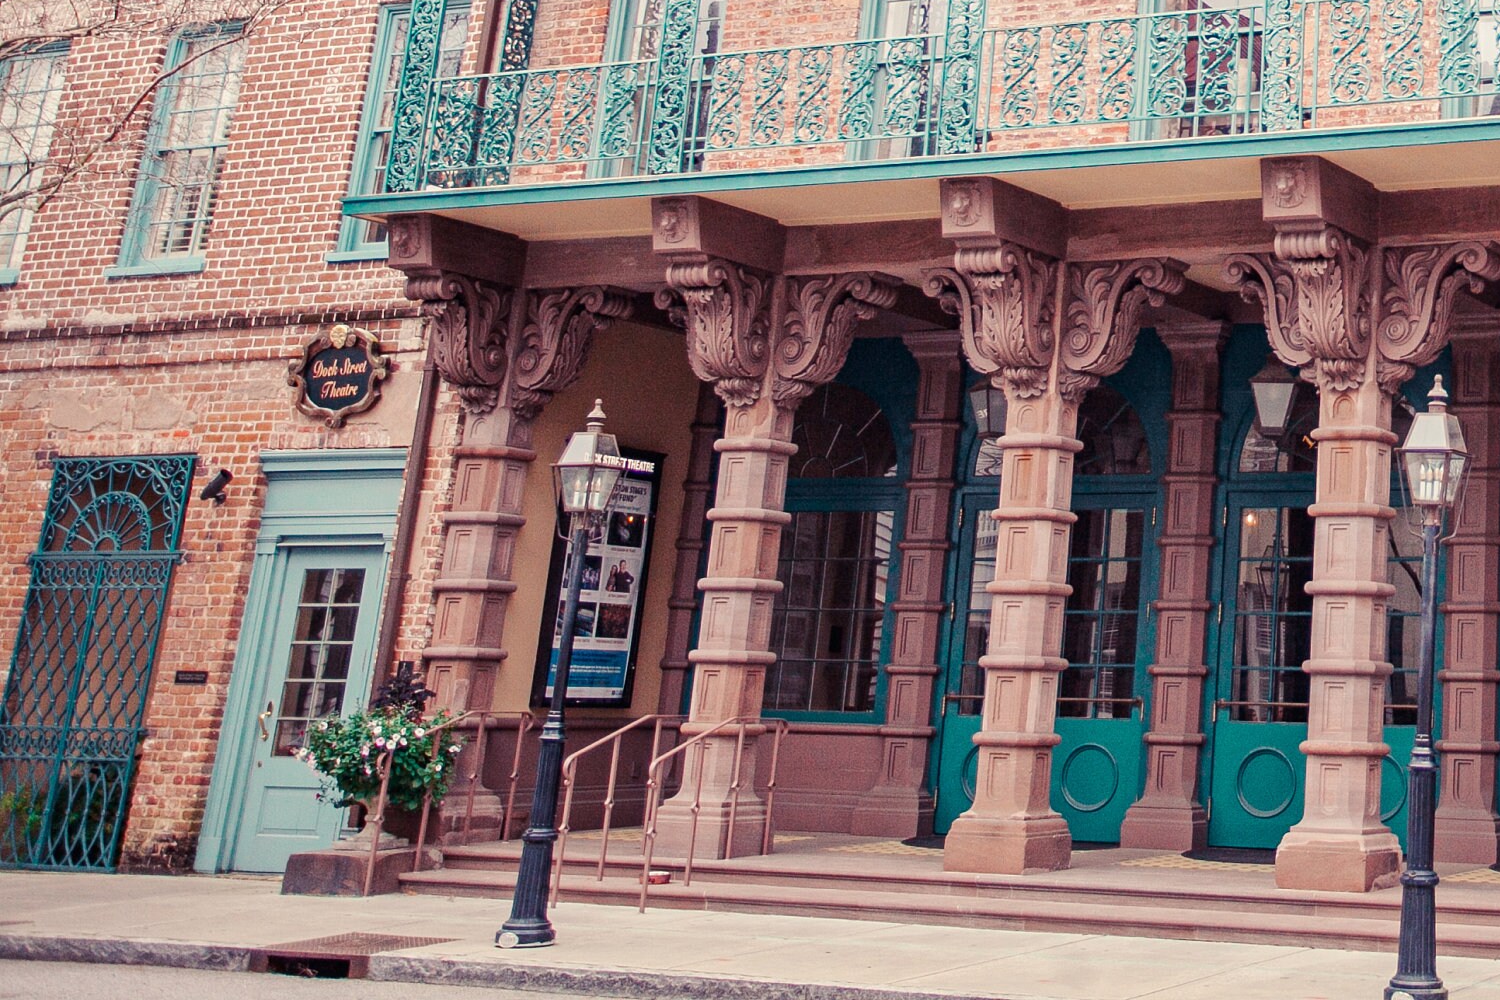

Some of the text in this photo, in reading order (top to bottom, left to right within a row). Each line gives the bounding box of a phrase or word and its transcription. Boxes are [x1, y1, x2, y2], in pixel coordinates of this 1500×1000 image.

[313, 357, 367, 379] Dock Street
[321, 381, 359, 399] Theatre
[627, 458, 655, 473] THEATRE
